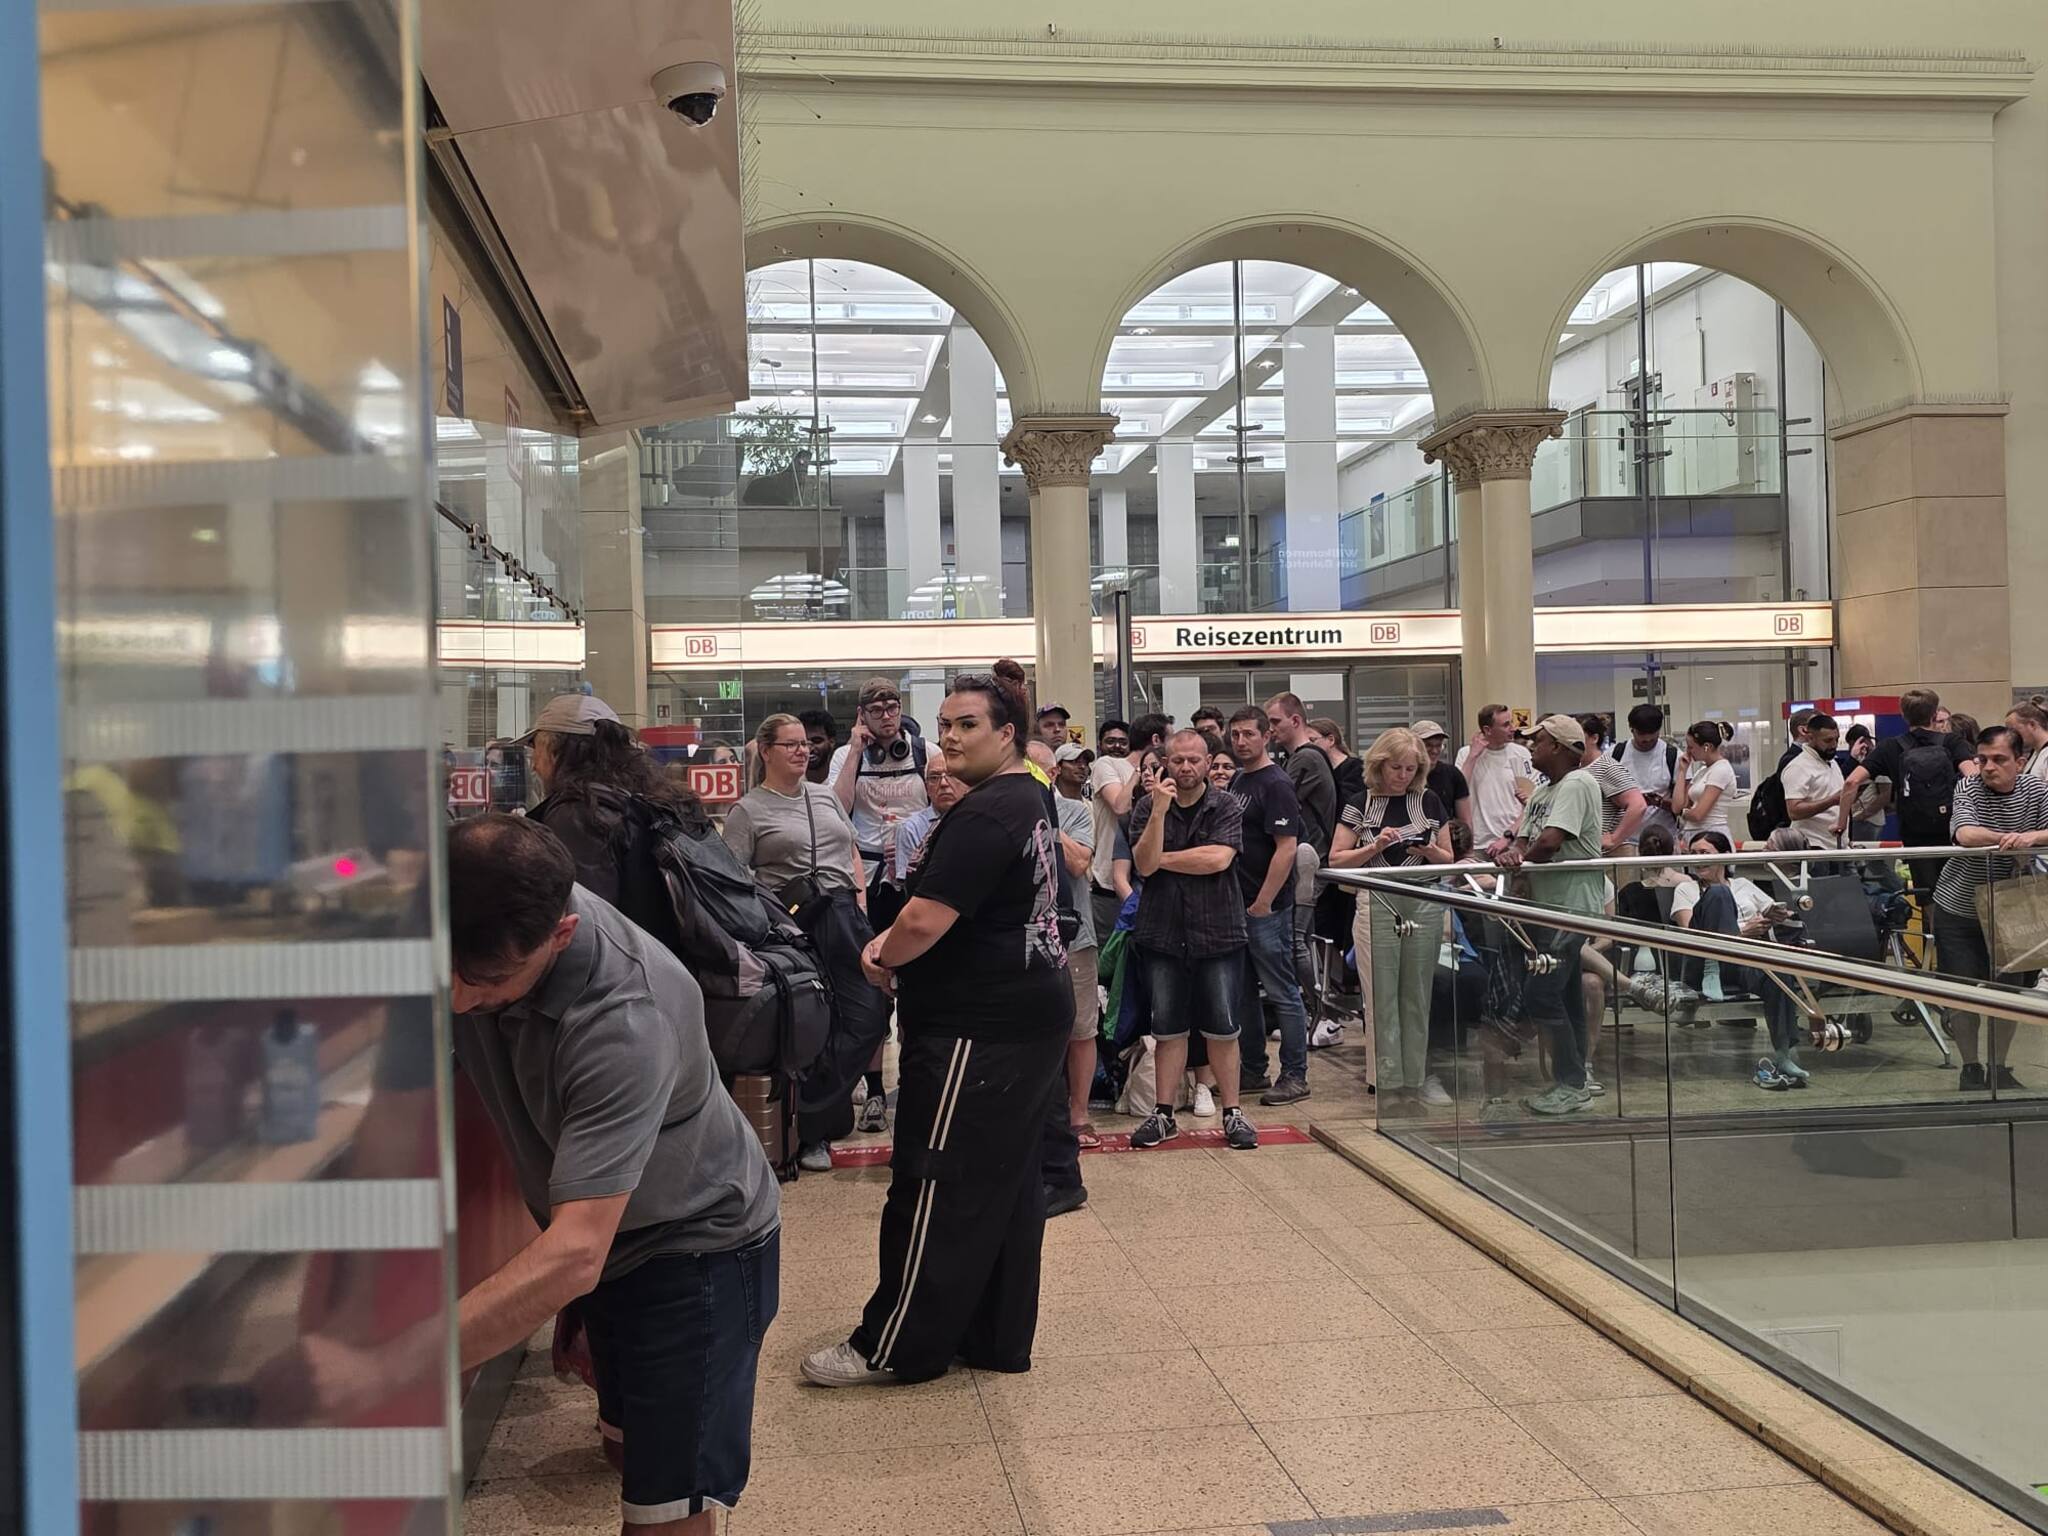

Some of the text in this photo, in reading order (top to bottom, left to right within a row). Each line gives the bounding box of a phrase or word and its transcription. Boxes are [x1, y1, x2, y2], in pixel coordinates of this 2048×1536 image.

[1778, 617, 1800, 632] DB
[1131, 625, 1397, 647] B Reisezentrum DB
[688, 639, 714, 654] DB
[694, 771, 734, 797] DB
